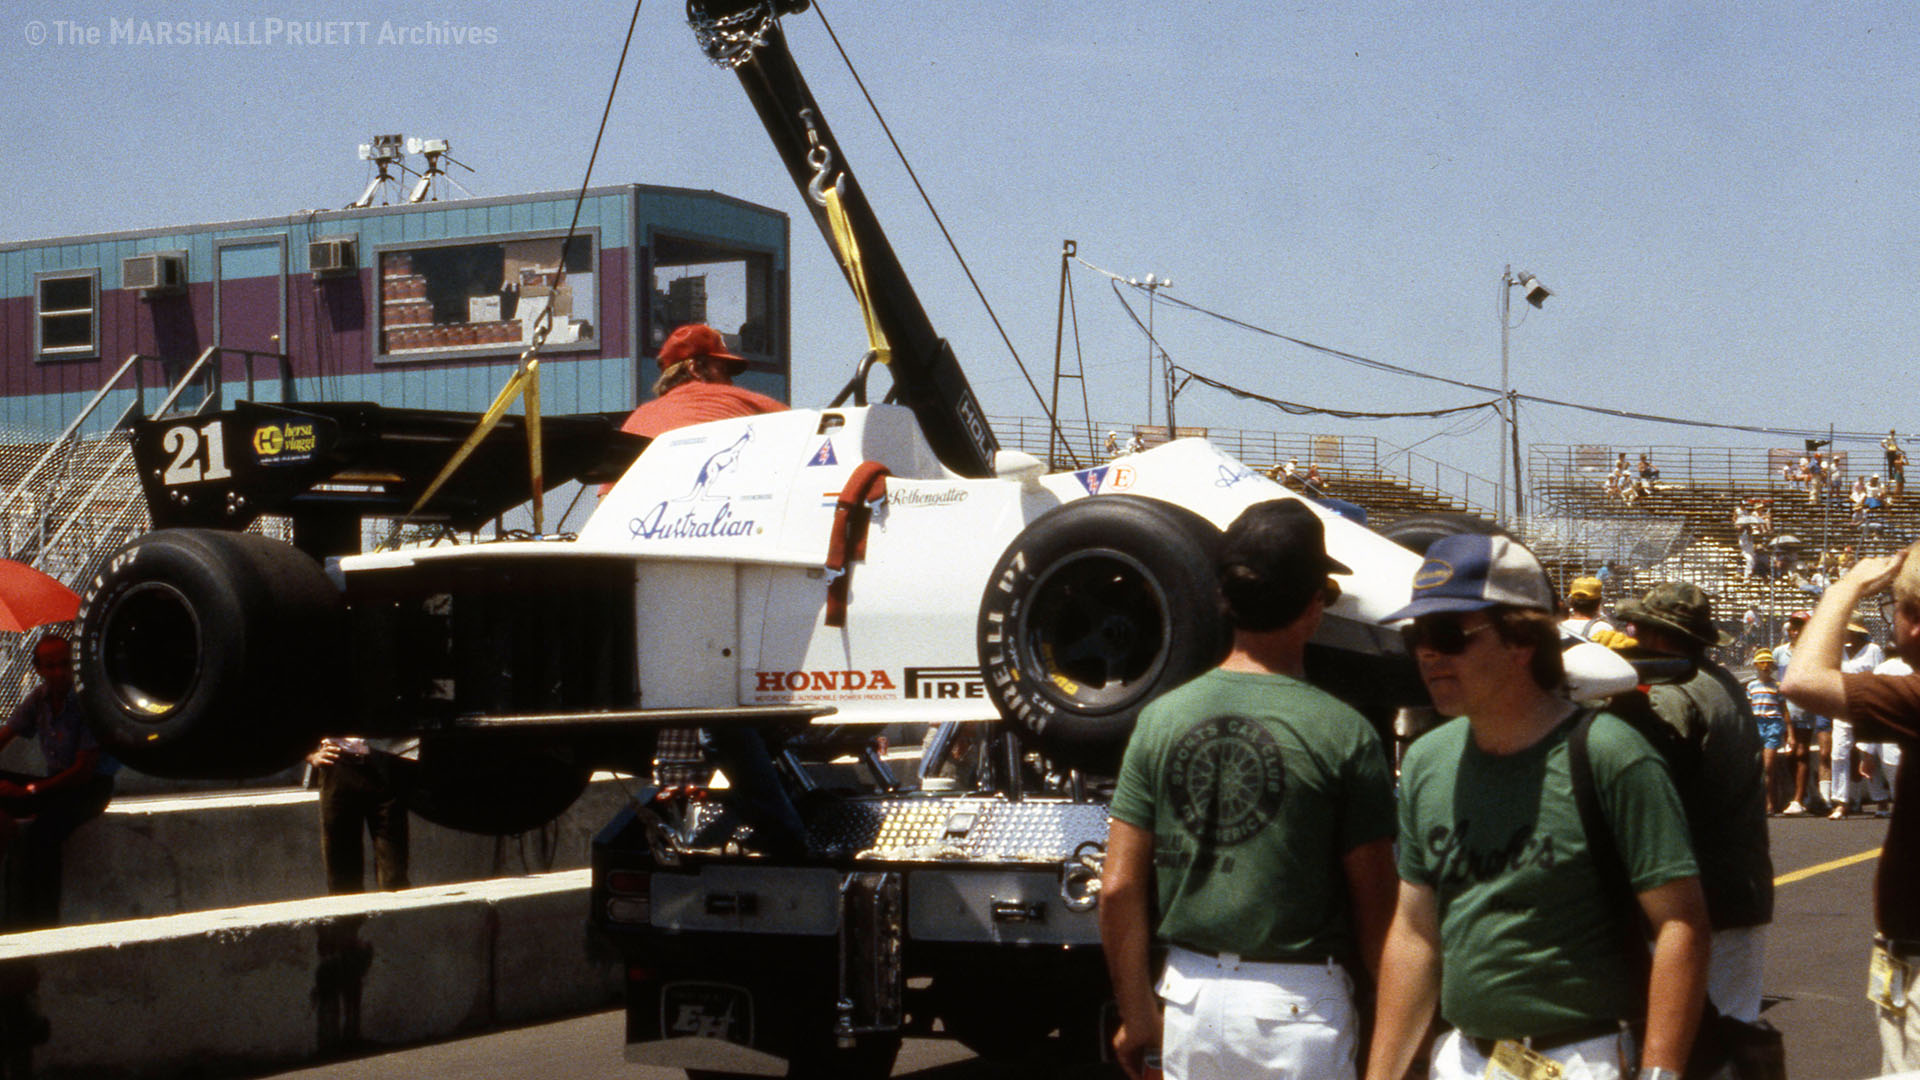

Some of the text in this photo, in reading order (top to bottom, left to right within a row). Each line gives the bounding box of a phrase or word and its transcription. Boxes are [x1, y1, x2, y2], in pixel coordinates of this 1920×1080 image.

[163, 421, 232, 486] 21
[629, 501, 754, 540] Australian
[998, 551, 1027, 593] P7
[755, 669, 896, 692] HONDA
[904, 667, 984, 699] PIRE
[987, 612, 1048, 735] PIRELLI
